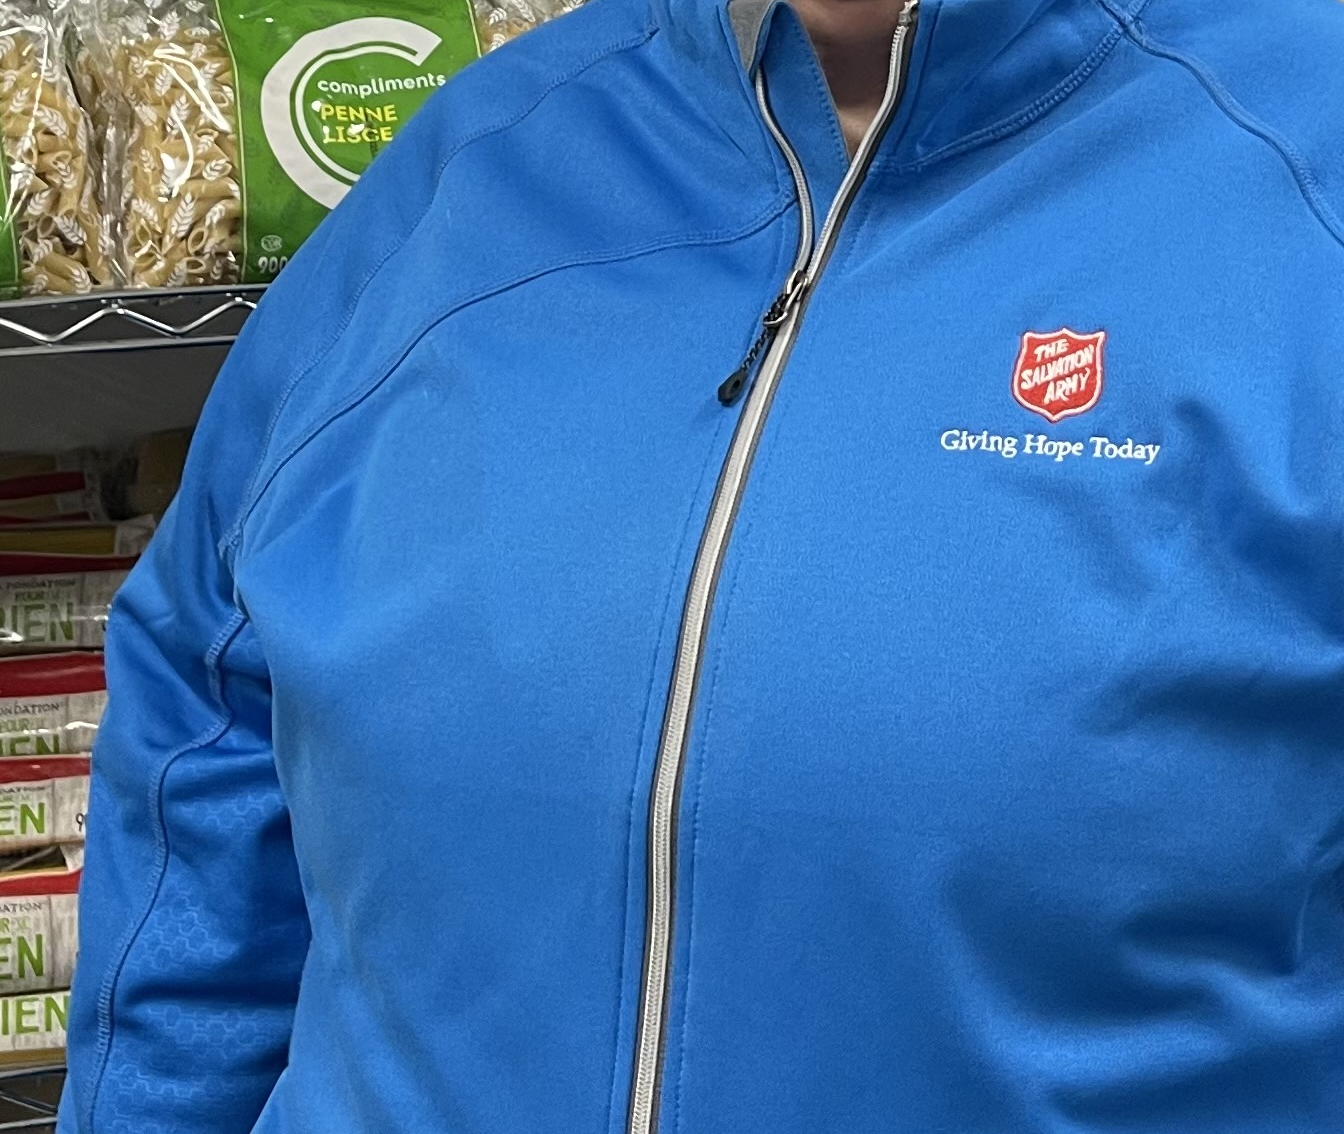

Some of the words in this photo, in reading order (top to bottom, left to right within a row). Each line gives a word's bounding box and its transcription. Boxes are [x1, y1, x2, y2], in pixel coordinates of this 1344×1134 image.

[317, 71, 447, 98] compliments
[320, 102, 398, 123] PENNE
[1034, 338, 1069, 363] THE
[1020, 344, 1095, 391] SALVATION
[1043, 368, 1090, 404] ARMY
[940, 429, 1018, 459] Giving
[1023, 433, 1084, 462] Hope
[1090, 436, 1160, 465] Today
